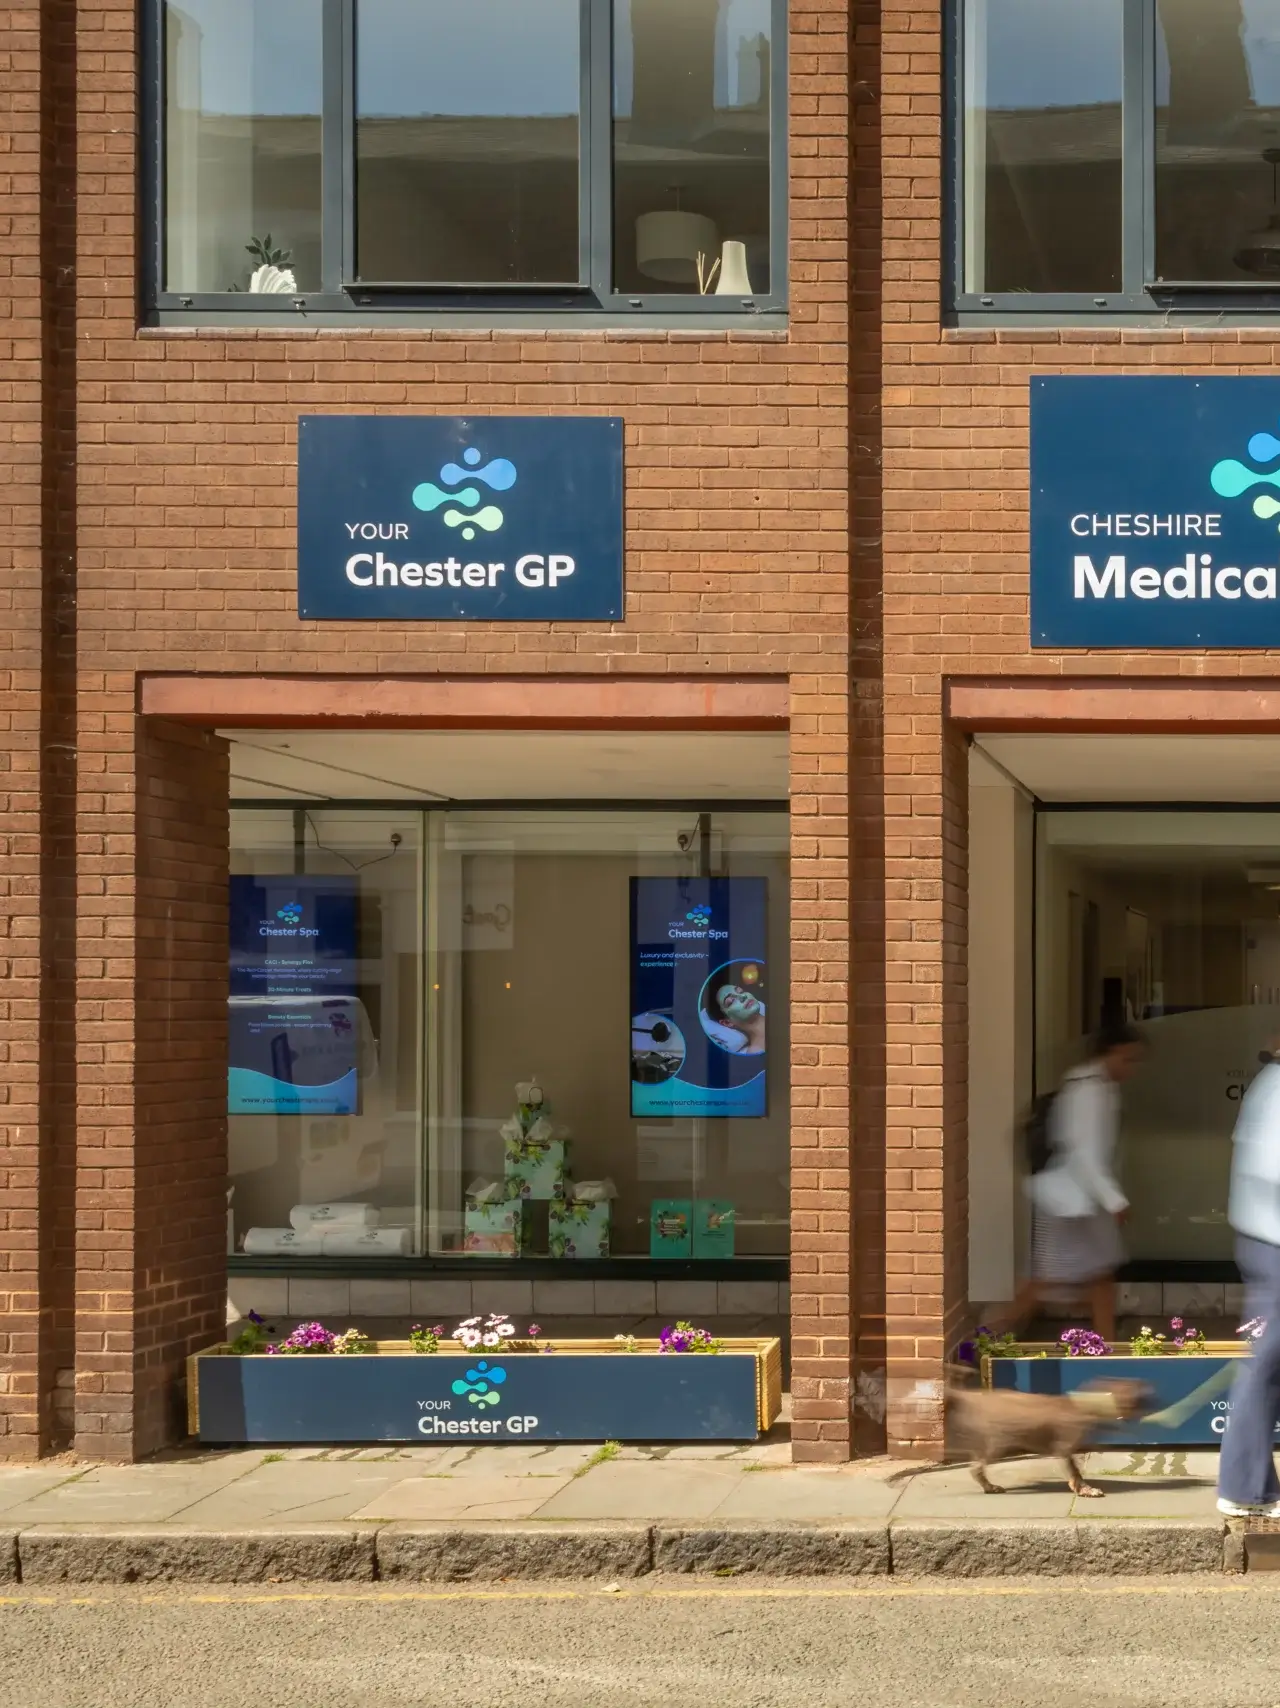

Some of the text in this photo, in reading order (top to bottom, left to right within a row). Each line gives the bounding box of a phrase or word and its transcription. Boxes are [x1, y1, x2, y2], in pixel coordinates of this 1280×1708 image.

[1070, 514, 1222, 537] CHESHIRE
[345, 523, 409, 540] YOUR
[345, 552, 575, 587] Chester GP
[259, 927, 319, 938] Chester Spa
[668, 929, 728, 940] Chester Spa
[640, 952, 661, 960] Luxury
[674, 952, 704, 960] exclusivity
[417, 1400, 451, 1410] YOUR
[1210, 1401, 1235, 1410] YOU
[418, 1415, 539, 1434] Chester GP
